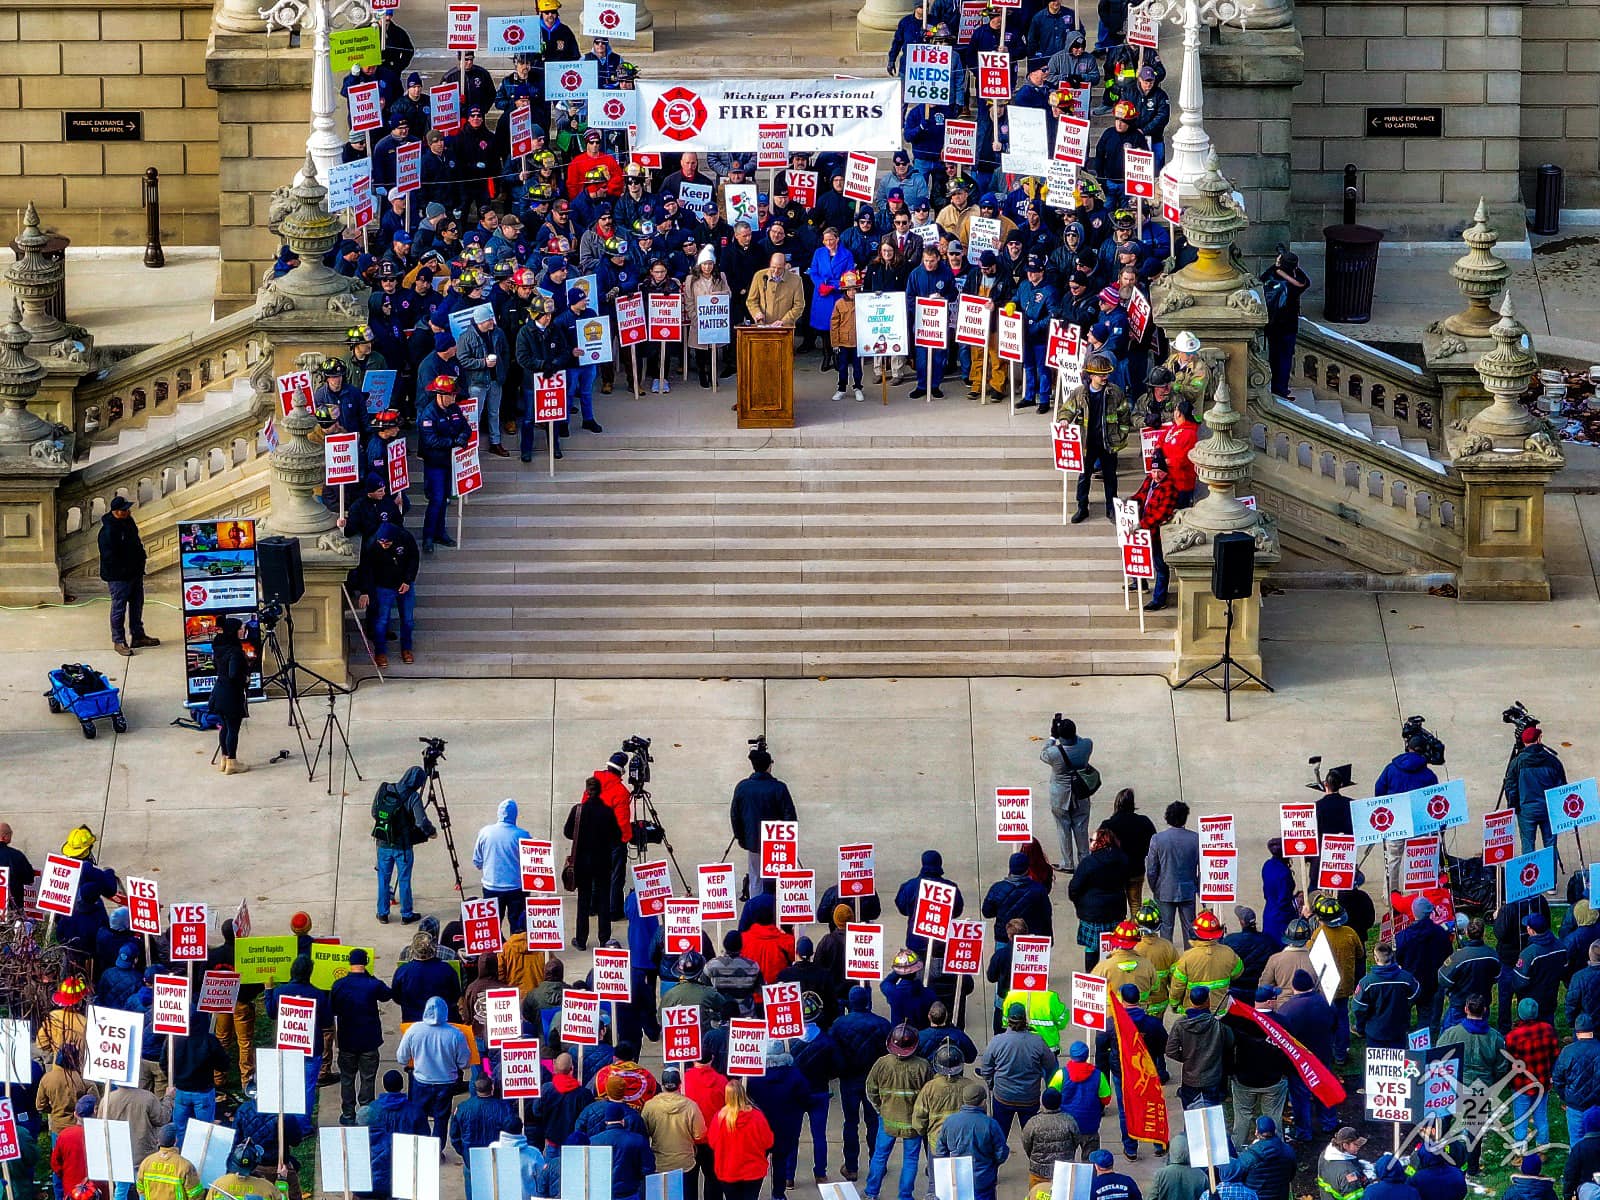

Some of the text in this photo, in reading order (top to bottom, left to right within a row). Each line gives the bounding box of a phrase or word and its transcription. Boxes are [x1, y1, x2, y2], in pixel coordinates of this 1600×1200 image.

[912, 50, 948, 64] 1188
[982, 54, 1008, 68] YES
[910, 68, 950, 81] NEEDS
[723, 90, 874, 102] Michigan Professional
[908, 86, 949, 100] 4688
[718, 105, 884, 119] FIRE FIGHTERS
[759, 131, 787, 139] SUPPORT
[1064, 136, 1080, 144] YOUR
[950, 138, 970, 146] LOCAL
[946, 146, 972, 156] CONTROL
[1058, 145, 1082, 156] PROMISE
[1128, 155, 1151, 164] SUPPORT
[854, 164, 869, 172] KEEP
[789, 172, 815, 188] YES
[682, 186, 710, 200] Keep
[619, 302, 641, 312] SUPPORT
[698, 305, 728, 316] STAFFING
[923, 308, 938, 316] KEEP
[966, 304, 982, 314] KEEP
[700, 318, 728, 329] MATTERS
[922, 318, 940, 328] YOUR
[964, 316, 982, 325] YOUR
[917, 330, 944, 338] PROMISE
[1054, 322, 1078, 340] YES
[280, 378, 309, 392] YES
[538, 373, 565, 388] YES
[544, 398, 558, 406] HB
[538, 408, 563, 417] 4688
[1055, 426, 1078, 440] YES
[333, 444, 350, 452] KEEP
[1061, 450, 1074, 458] HB
[332, 455, 352, 464] YOUR
[1058, 458, 1080, 468] 4688
[328, 466, 356, 475] PROMISE
[1124, 531, 1148, 546] YES
[1130, 556, 1144, 564] HB
[1127, 565, 1150, 575] 4688
[998, 798, 1028, 808] SUPPORT
[1002, 811, 1026, 820] LOCAL
[1284, 811, 1314, 819] SUPPORT
[1201, 822, 1232, 832] SUPPORT
[1486, 816, 1512, 828] SUPPORT
[765, 824, 796, 840] YES
[998, 823, 1029, 832] CONTROL
[1493, 827, 1506, 836] FIRE
[1284, 830, 1316, 838] FIGHTERS
[1484, 835, 1514, 846] FIGHTERS
[522, 846, 550, 856] SUPPORT
[1324, 842, 1354, 852] SUPPORT
[771, 852, 787, 862] HB
[841, 850, 871, 860] SUPPORT
[1210, 860, 1228, 868] KEEP
[707, 874, 726, 884] KEEP
[840, 870, 873, 878] FIGHTERS
[1208, 872, 1229, 880] YOUR
[130, 880, 156, 898] YES
[780, 880, 812, 889] SUPPORT
[1202, 884, 1234, 892] PROMISE
[42, 890, 72, 904] PROMISE
[638, 886, 671, 898] FIGHTERS
[706, 888, 728, 897] YOUR
[784, 892, 808, 902] LOCAL
[924, 882, 952, 904] YES
[465, 901, 496, 918] YES
[668, 906, 698, 914] SUPPORT
[702, 902, 734, 910] PROMISE
[781, 904, 812, 914] CONTROL
[138, 908, 151, 918] HB
[175, 906, 206, 922] YES
[528, 908, 560, 916] SUPPORT
[134, 918, 158, 930] 4688
[476, 920, 488, 928] ON
[532, 920, 558, 928] LOCAL
[918, 922, 946, 936] 4688
[475, 930, 491, 939] HB
[530, 931, 560, 940] CONTROL
[952, 922, 982, 940] YES
[182, 935, 197, 944] HB
[470, 938, 498, 950] 4688
[854, 935, 874, 944] KEEP
[175, 946, 204, 956] 4688
[854, 948, 875, 958] YOUR
[1016, 944, 1048, 952] SUPPORT
[956, 950, 972, 959] HB
[1024, 954, 1038, 962] FIRE
[595, 958, 628, 969] SUPPORT
[848, 960, 880, 970] PROMISE
[948, 960, 976, 970] 4688
[1014, 964, 1048, 972] FIGHTERS
[600, 971, 624, 980] LOCAL
[596, 982, 628, 992] CONTROL
[156, 987, 186, 998] SUPPORT
[767, 984, 798, 1002] YES
[160, 1001, 182, 1011] LOCAL
[564, 1000, 597, 1011] SUPPORT
[280, 1007, 312, 1019] SUPPORT
[568, 1012, 592, 1022] LOCAL
[666, 1010, 698, 1026] YES
[156, 1013, 186, 1024] CONTROL
[777, 1014, 792, 1024] HB
[283, 1020, 308, 1032] LOCAL
[564, 1024, 596, 1035] CONTROL
[772, 1024, 800, 1036] 4688
[98, 1025, 126, 1039] YES
[731, 1030, 764, 1041] SUPPORT
[279, 1033, 311, 1045] CONTROL
[674, 1037, 690, 1046] HB
[1411, 1034, 1429, 1050] YES
[668, 1047, 698, 1057] 4688
[735, 1043, 760, 1053] LOCAL
[504, 1052, 536, 1061] SUPPORT
[1368, 1048, 1404, 1062] STAFFING
[93, 1057, 126, 1070] 4688
[731, 1055, 762, 1066] CONTROL
[508, 1064, 534, 1074] LOCAL
[1368, 1064, 1402, 1078] MATTERS
[504, 1077, 536, 1087] CONTROL
[1377, 1082, 1407, 1094] YES
[1376, 1109, 1410, 1120] 4688
[1096, 1184, 1128, 1194] WESTLAND
